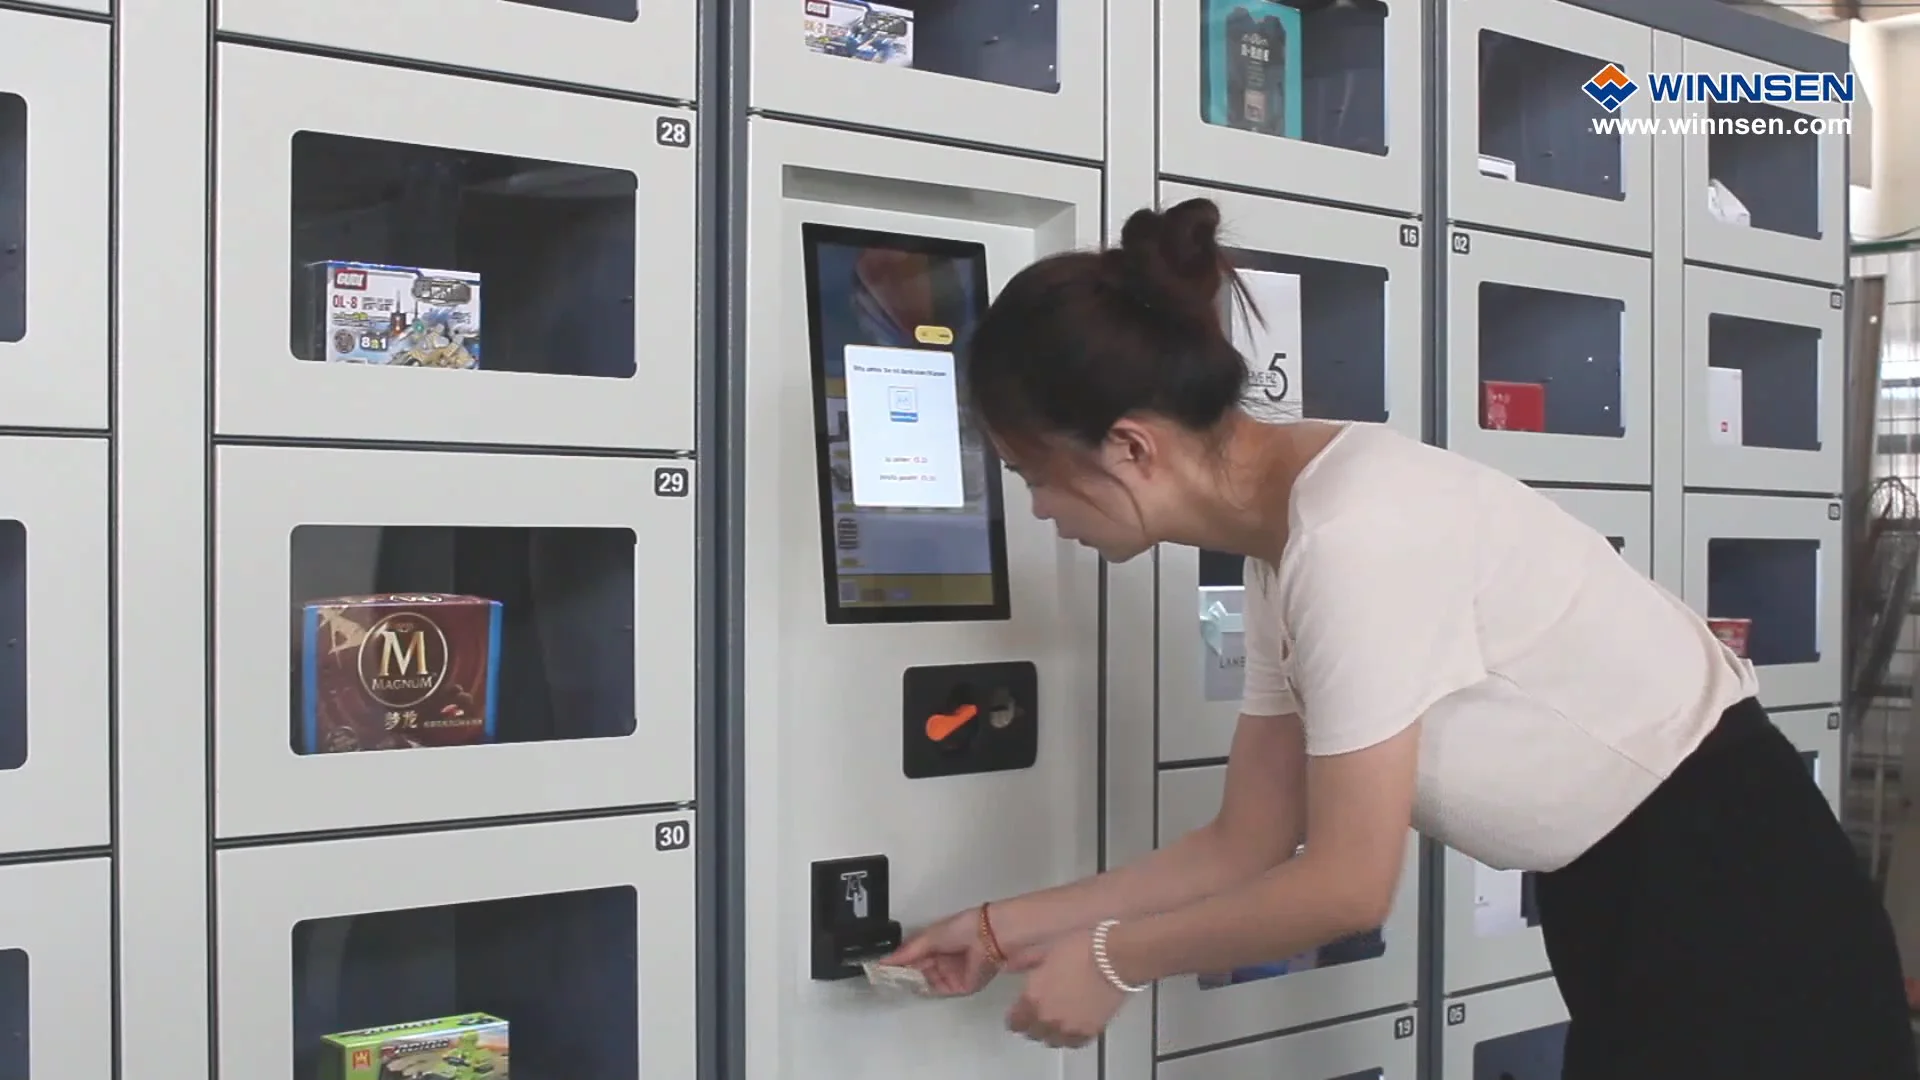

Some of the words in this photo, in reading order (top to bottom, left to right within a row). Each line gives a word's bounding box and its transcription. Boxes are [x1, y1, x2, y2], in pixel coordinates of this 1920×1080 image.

[661, 121, 686, 144] 28
[1402, 228, 1417, 244] 16
[1454, 235, 1468, 252] 02
[1264, 352, 1288, 402] 5
[659, 472, 684, 493] 29
[378, 630, 429, 677] M
[371, 676, 433, 690] MAGNUM
[660, 825, 685, 847] 30
[1398, 1018, 1411, 1036] 19
